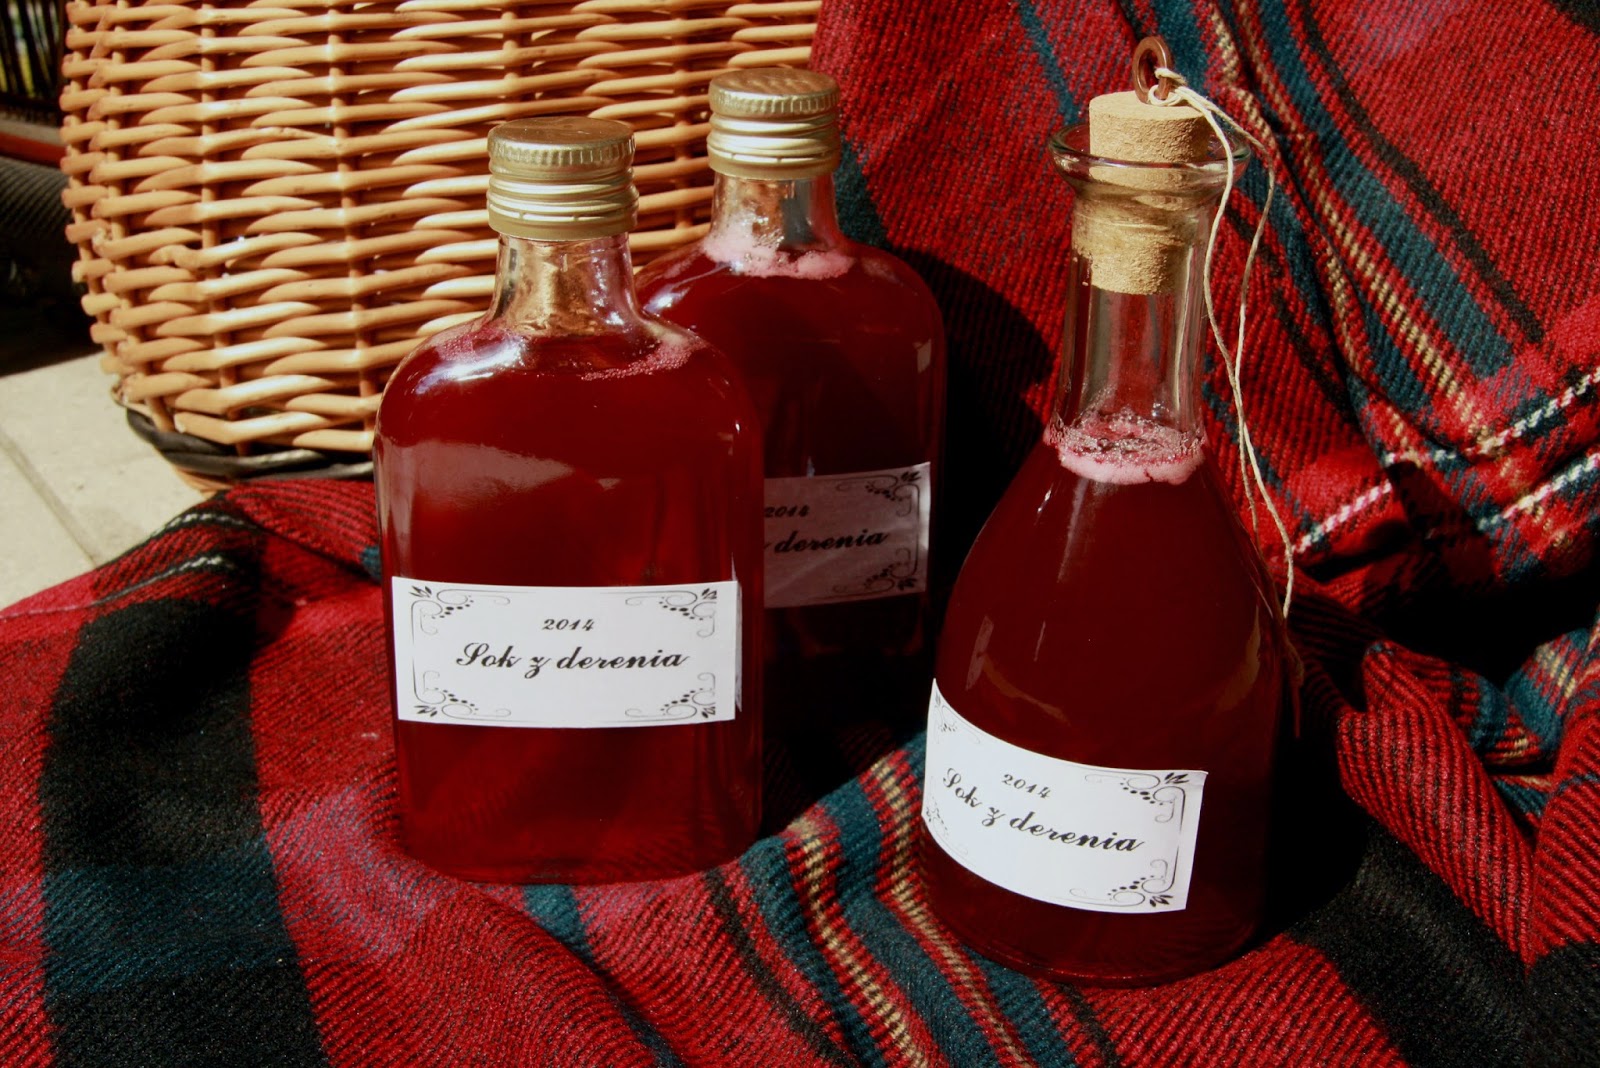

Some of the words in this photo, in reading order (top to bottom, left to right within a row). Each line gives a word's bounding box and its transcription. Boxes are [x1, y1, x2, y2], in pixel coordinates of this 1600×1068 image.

[774, 529, 890, 553] derenia
[541, 618, 595, 631] 2014
[456, 642, 522, 668] Sok
[524, 655, 551, 679] z
[556, 646, 690, 669] derenia
[1001, 773, 1051, 799] 2014
[942, 767, 982, 808] Sok
[981, 806, 1006, 827] z
[1009, 811, 1145, 852] derenia
